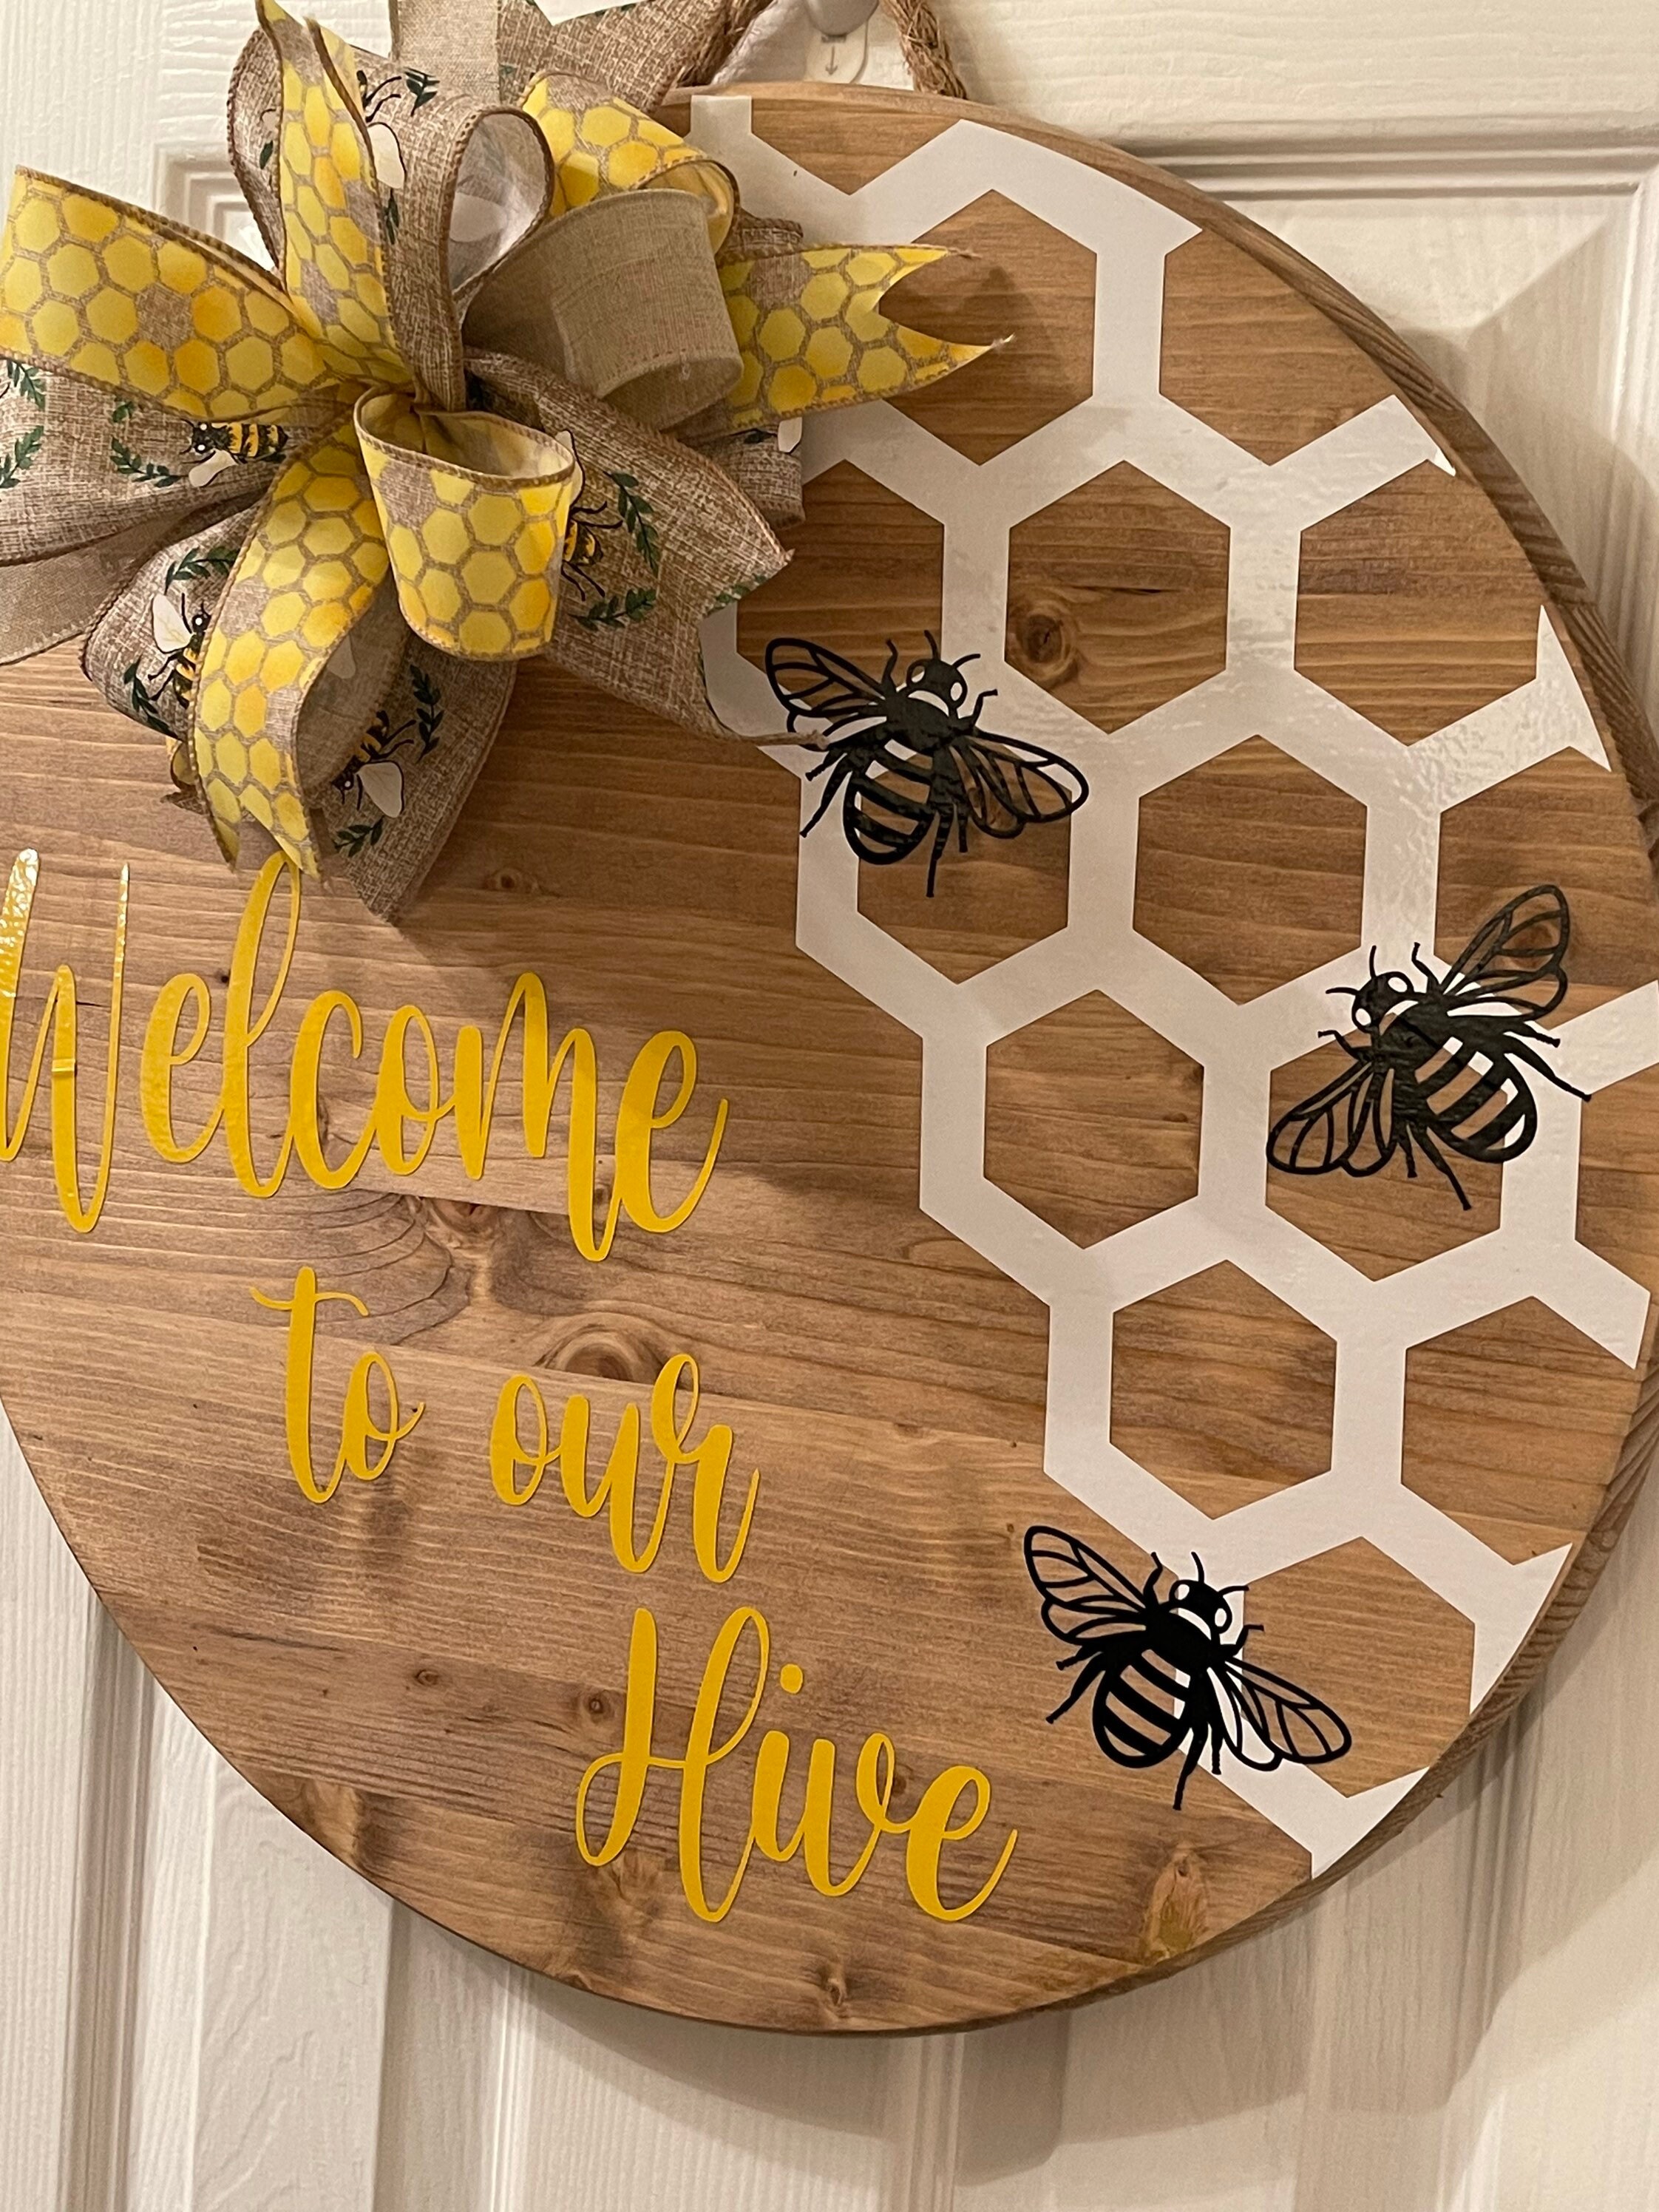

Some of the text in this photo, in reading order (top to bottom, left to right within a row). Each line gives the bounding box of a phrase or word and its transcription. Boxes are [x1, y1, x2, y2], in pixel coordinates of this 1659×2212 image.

[0, 849, 728, 1261] Welcome
[250, 1266, 760, 1582] to our
[576, 1607, 1017, 1921] Hive
